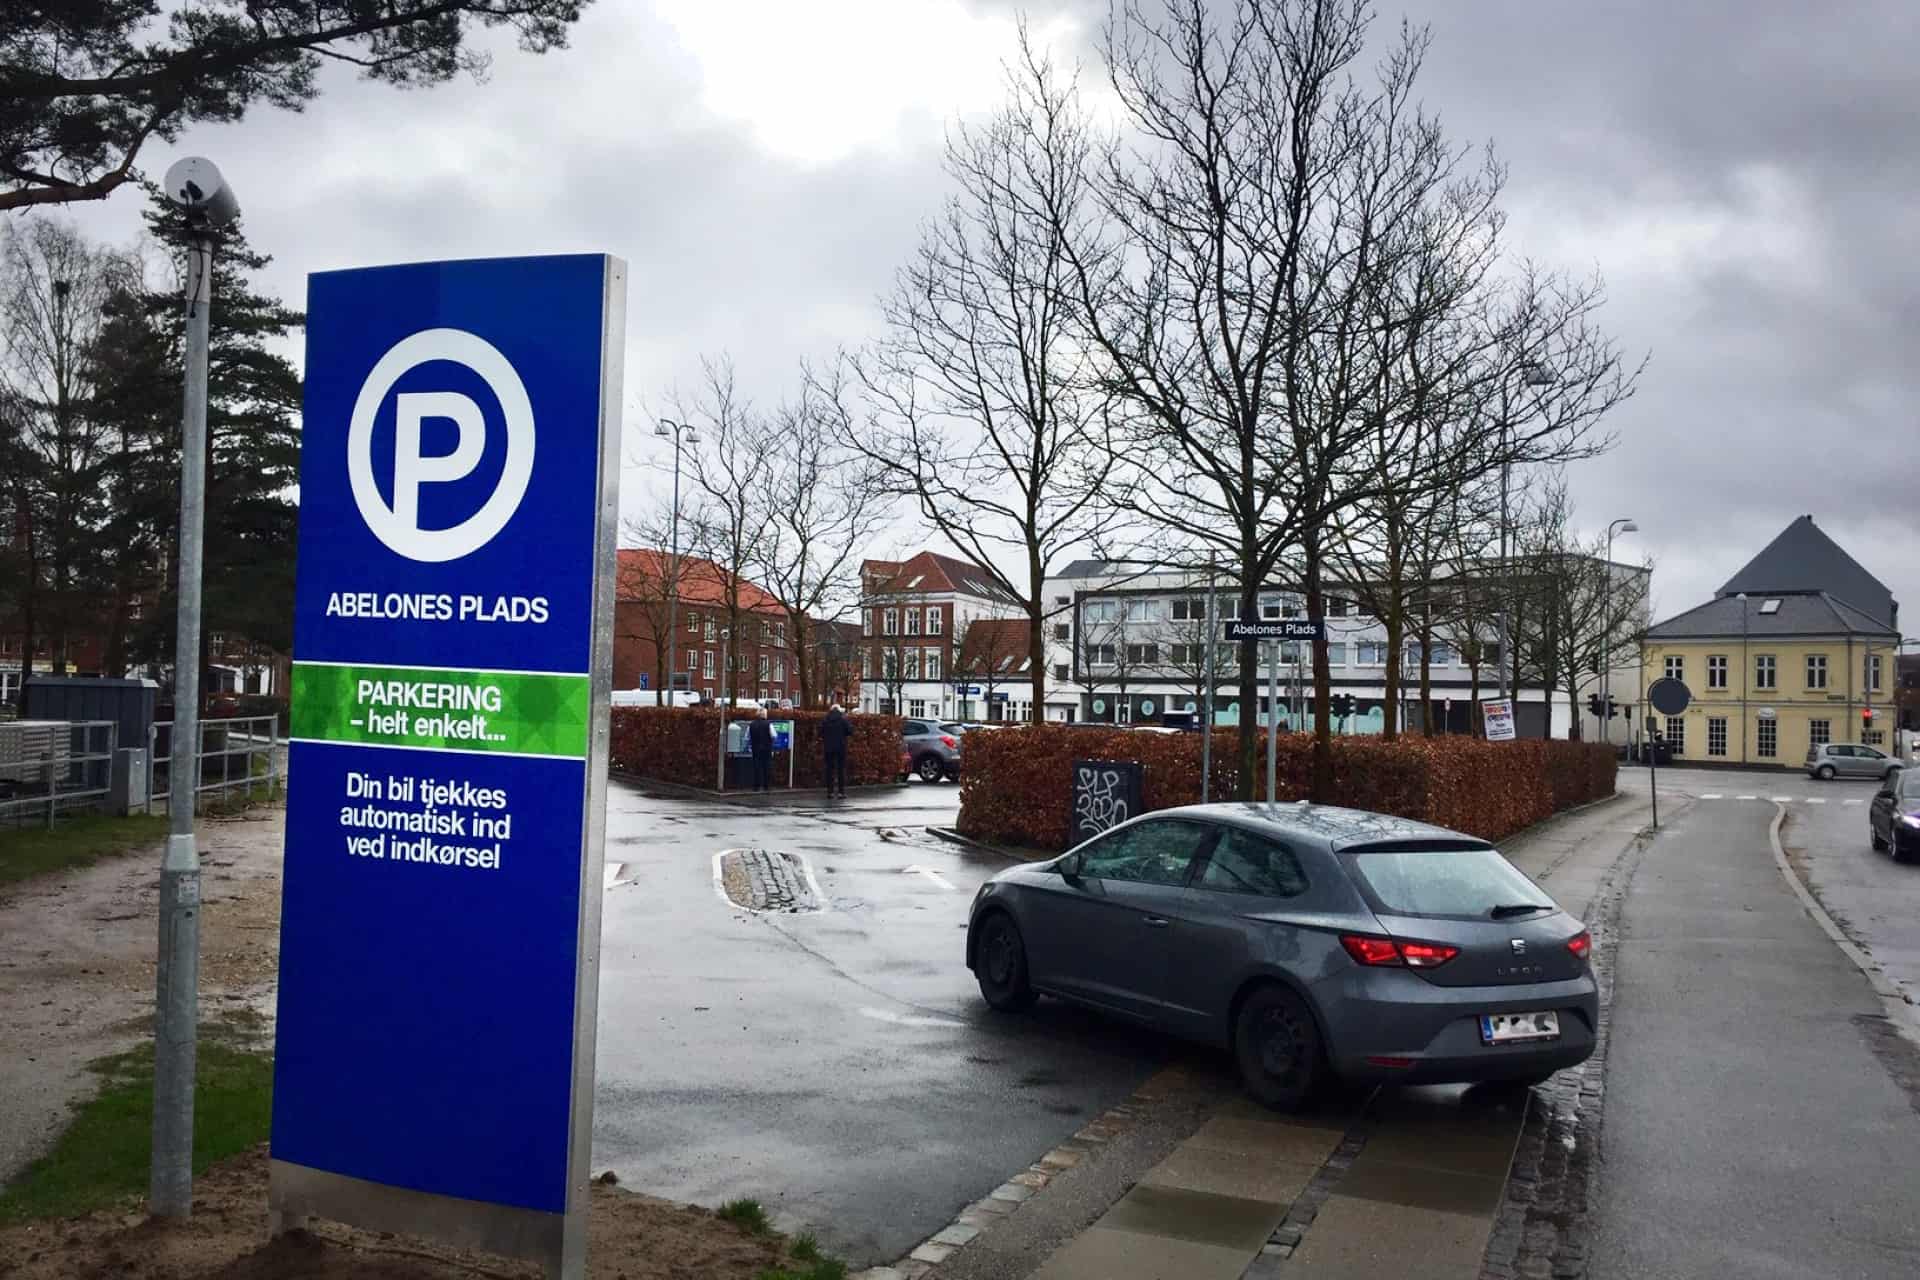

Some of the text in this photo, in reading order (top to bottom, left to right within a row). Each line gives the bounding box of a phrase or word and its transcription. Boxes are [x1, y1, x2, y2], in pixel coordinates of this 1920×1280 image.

[394, 391, 487, 530] P
[325, 592, 549, 623] ABELONES PLADS
[1232, 623, 1316, 635] Abelones Plads
[357, 679, 502, 712] PARKERING
[367, 708, 410, 735] helt
[414, 712, 507, 742] enkelt...
[346, 772, 507, 809] Din bil tjekkes
[340, 804, 511, 840] automatisk ind
[346, 833, 501, 869] ved indkørsel
